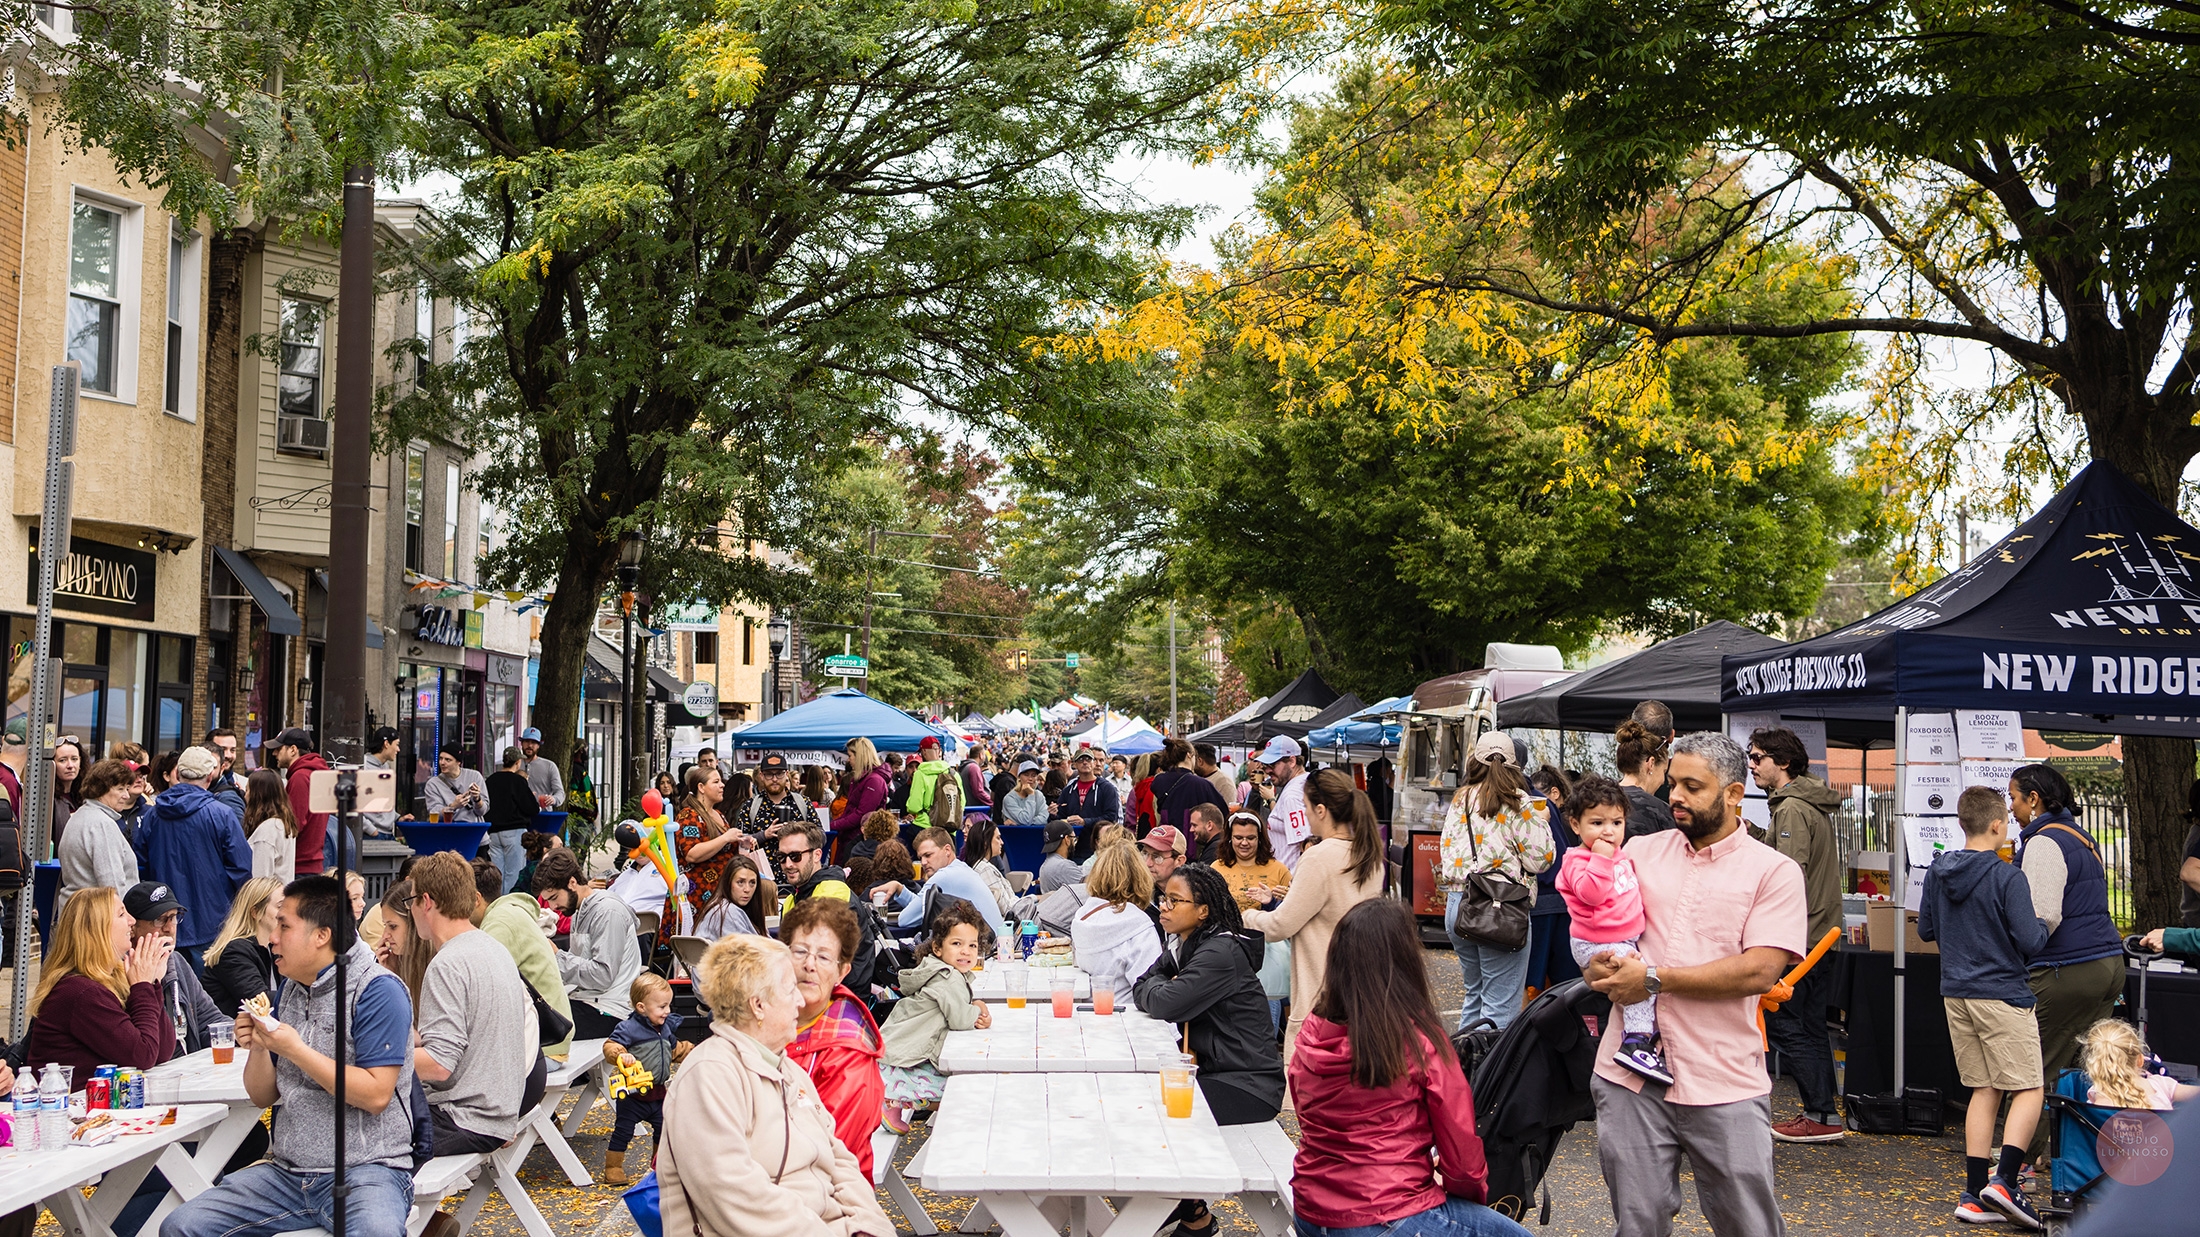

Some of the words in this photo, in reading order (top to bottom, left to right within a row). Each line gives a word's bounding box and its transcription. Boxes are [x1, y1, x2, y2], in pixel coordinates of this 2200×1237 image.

[2050, 604, 2160, 629] NEW
[2118, 628, 2200, 636] BREW
[826, 657, 858, 666] Conarroe
[1735, 664, 1760, 696] NEW
[1760, 658, 1792, 693] RIDGE
[1793, 654, 1846, 690] BREWING
[1847, 652, 1867, 688] CO.
[1982, 652, 2077, 692] NEW
[2091, 655, 2200, 696] RIDGE
[1289, 810, 1305, 828] 51
[1418, 843, 1439, 851] dulce
